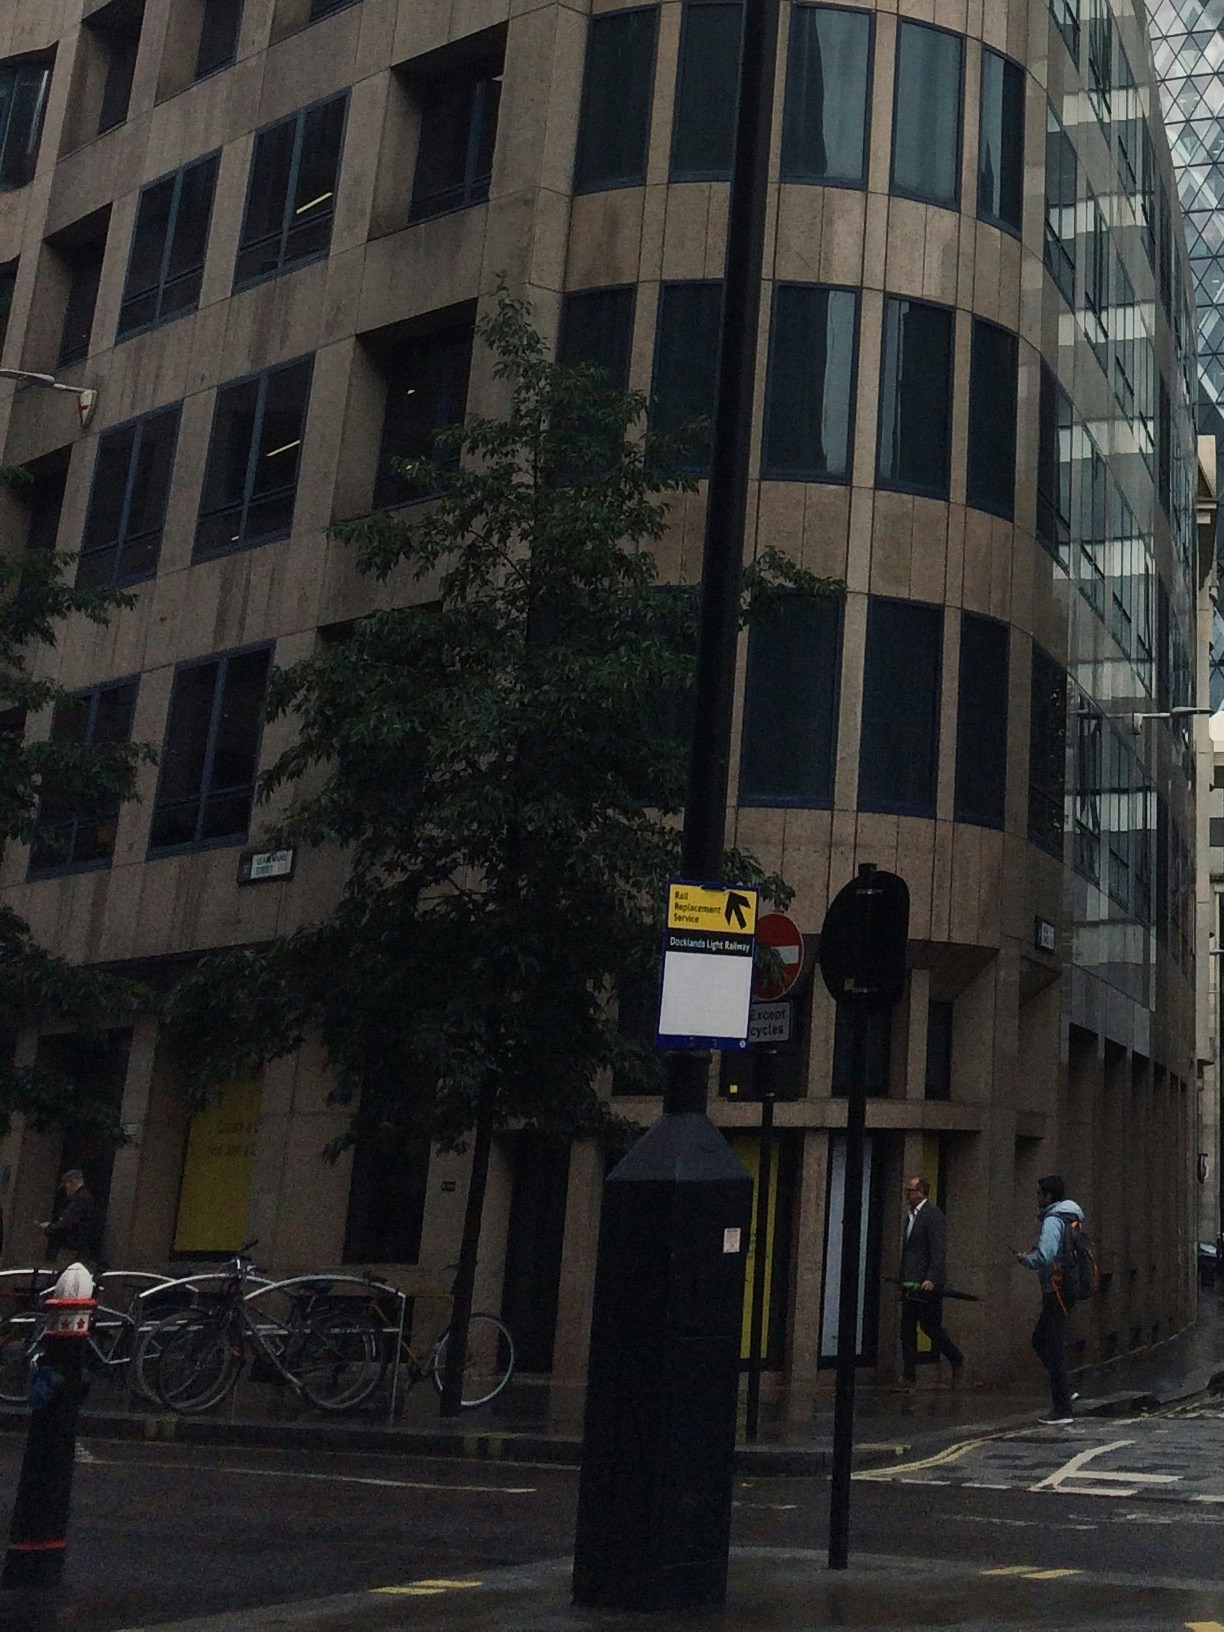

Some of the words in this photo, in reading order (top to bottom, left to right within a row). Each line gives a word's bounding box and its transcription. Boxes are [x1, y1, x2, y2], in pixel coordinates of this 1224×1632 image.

[674, 891, 689, 900] Rail
[674, 902, 722, 915] Replacement
[673, 913, 699, 924] Service
[669, 936, 706, 949] Docklands
[706, 939, 723, 951] Light
[724, 940, 751, 954] Railway
[750, 1008, 786, 1022] Except
[750, 1023, 784, 1038] cycles
